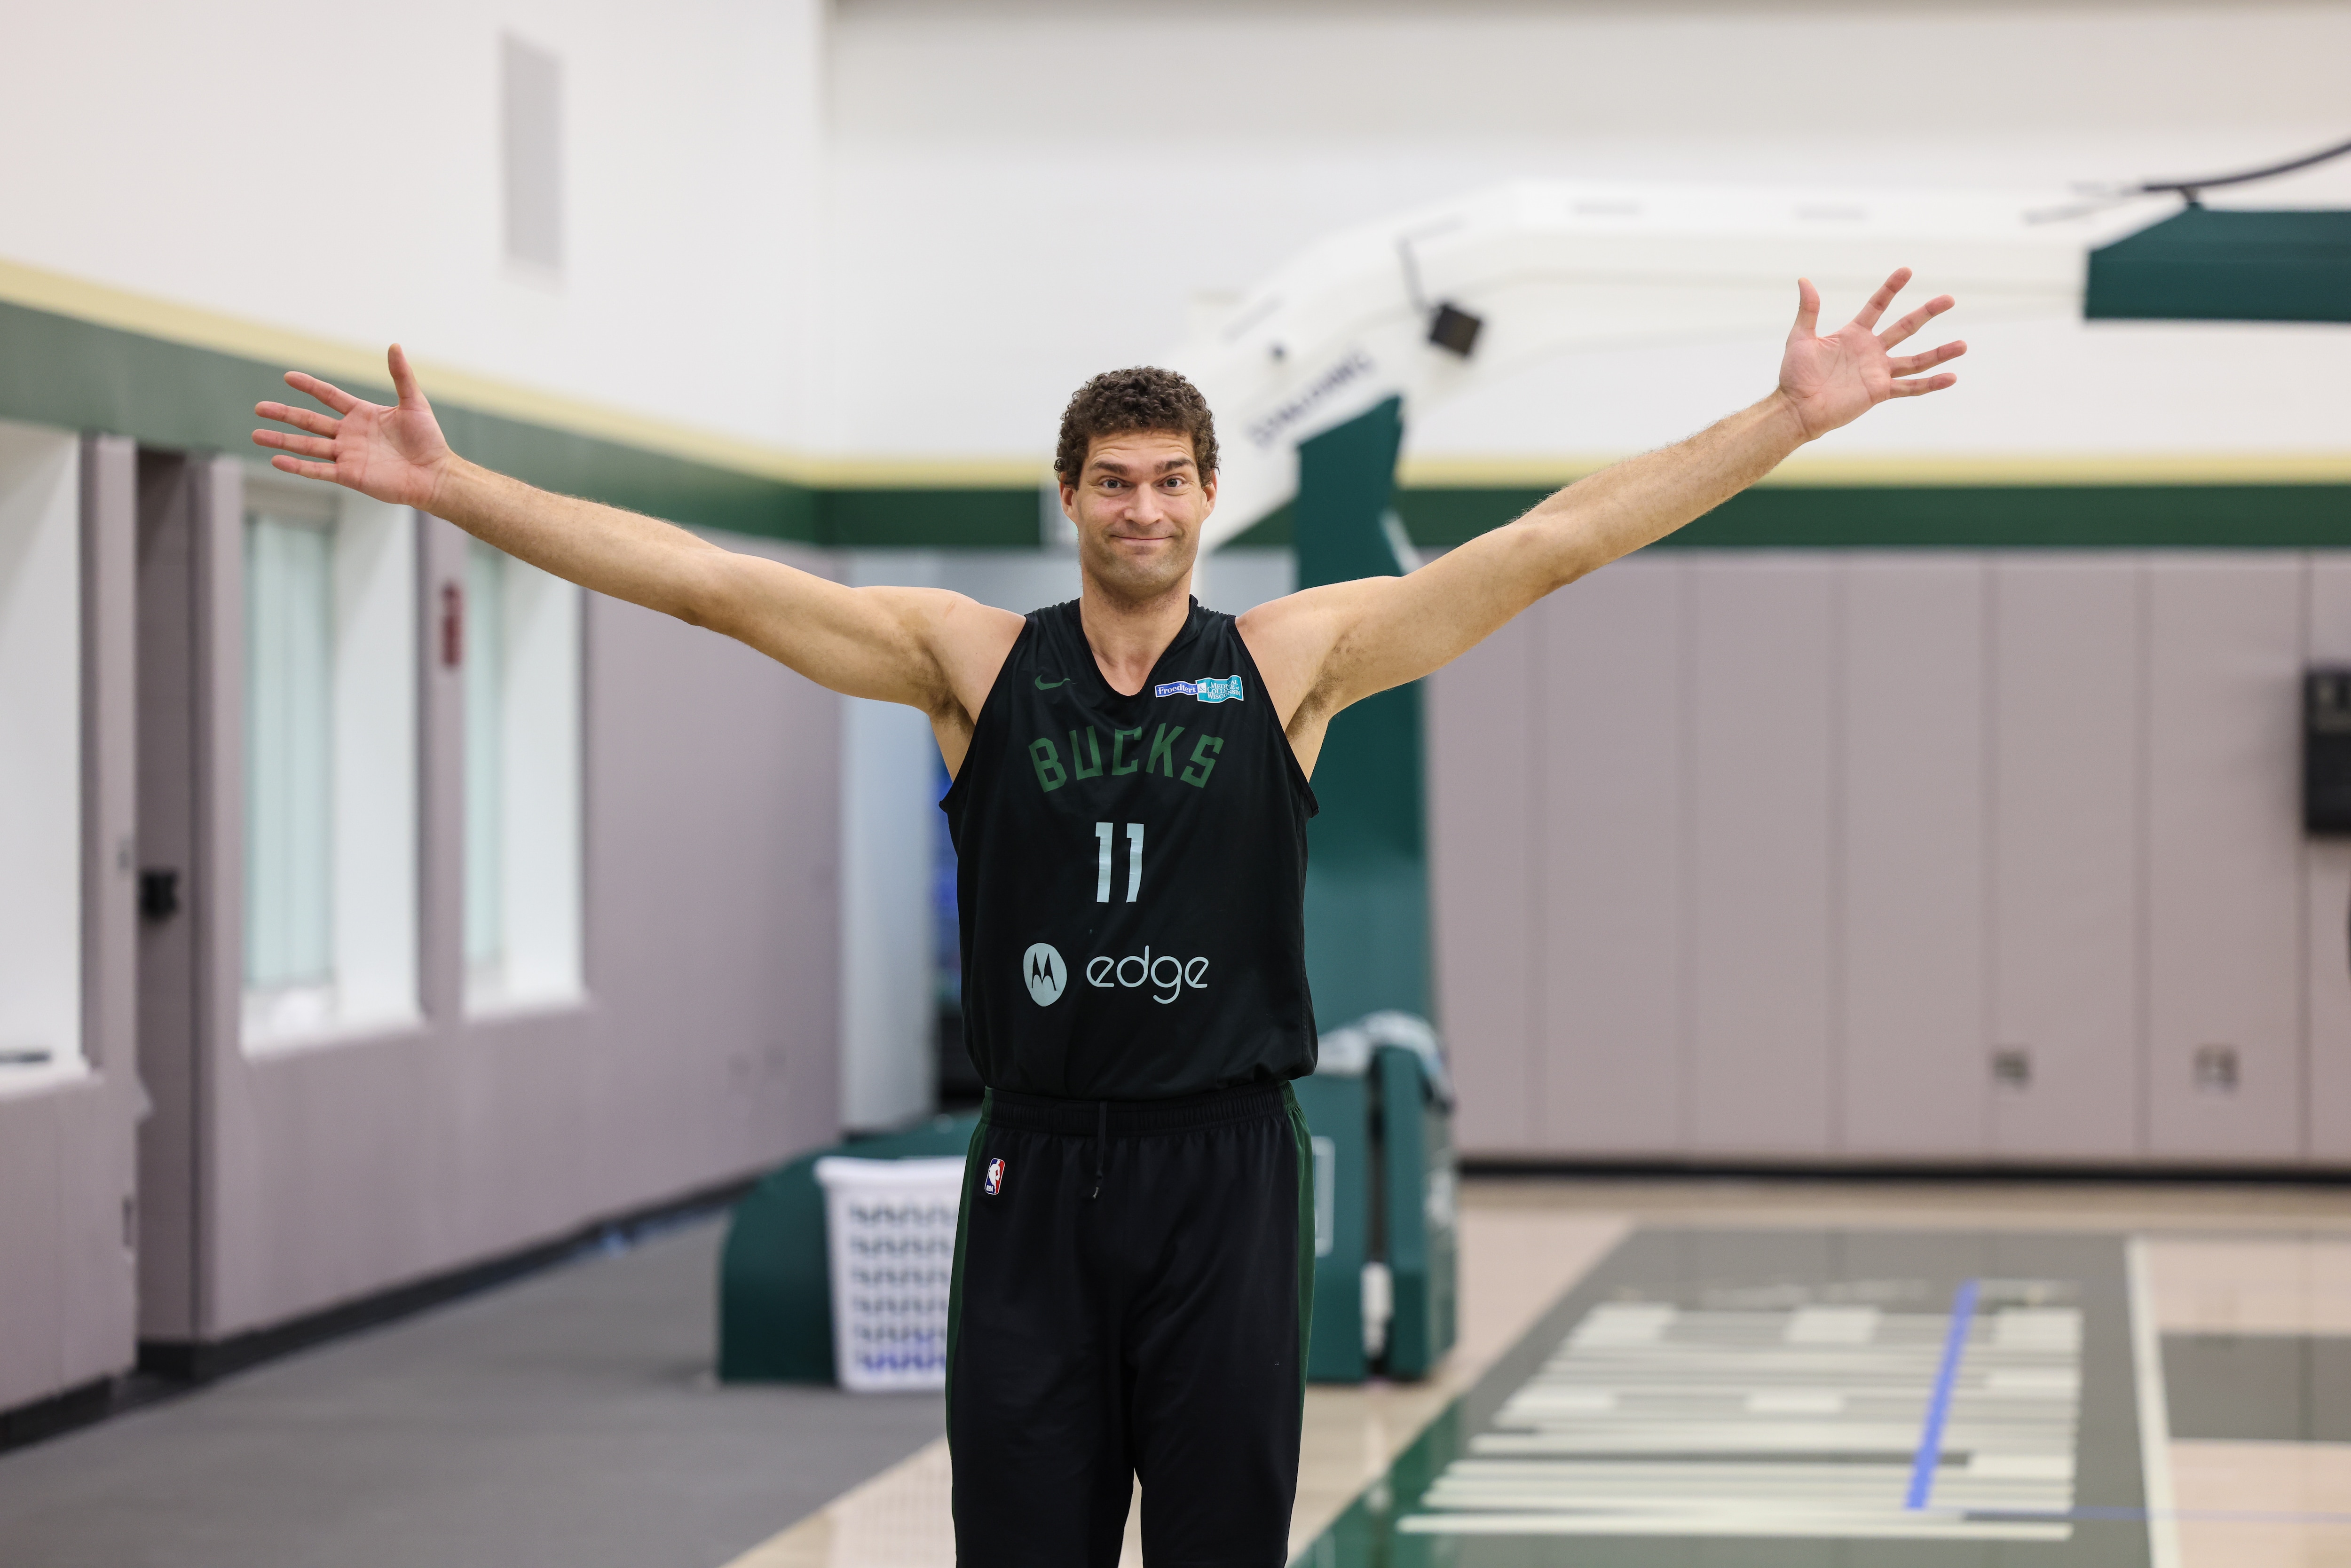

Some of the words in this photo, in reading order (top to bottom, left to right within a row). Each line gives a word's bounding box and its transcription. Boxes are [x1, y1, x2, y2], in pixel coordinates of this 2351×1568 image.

[1158, 684, 1197, 694] Froedtert
[1207, 685, 1235, 694] COLLEGE
[1211, 680, 1239, 690] MEDICAL
[1207, 689, 1240, 699] WISCONSIN
[1029, 723, 1224, 793] BUCKS
[1095, 822, 1144, 903] 11
[1086, 945, 1209, 1004] edge
